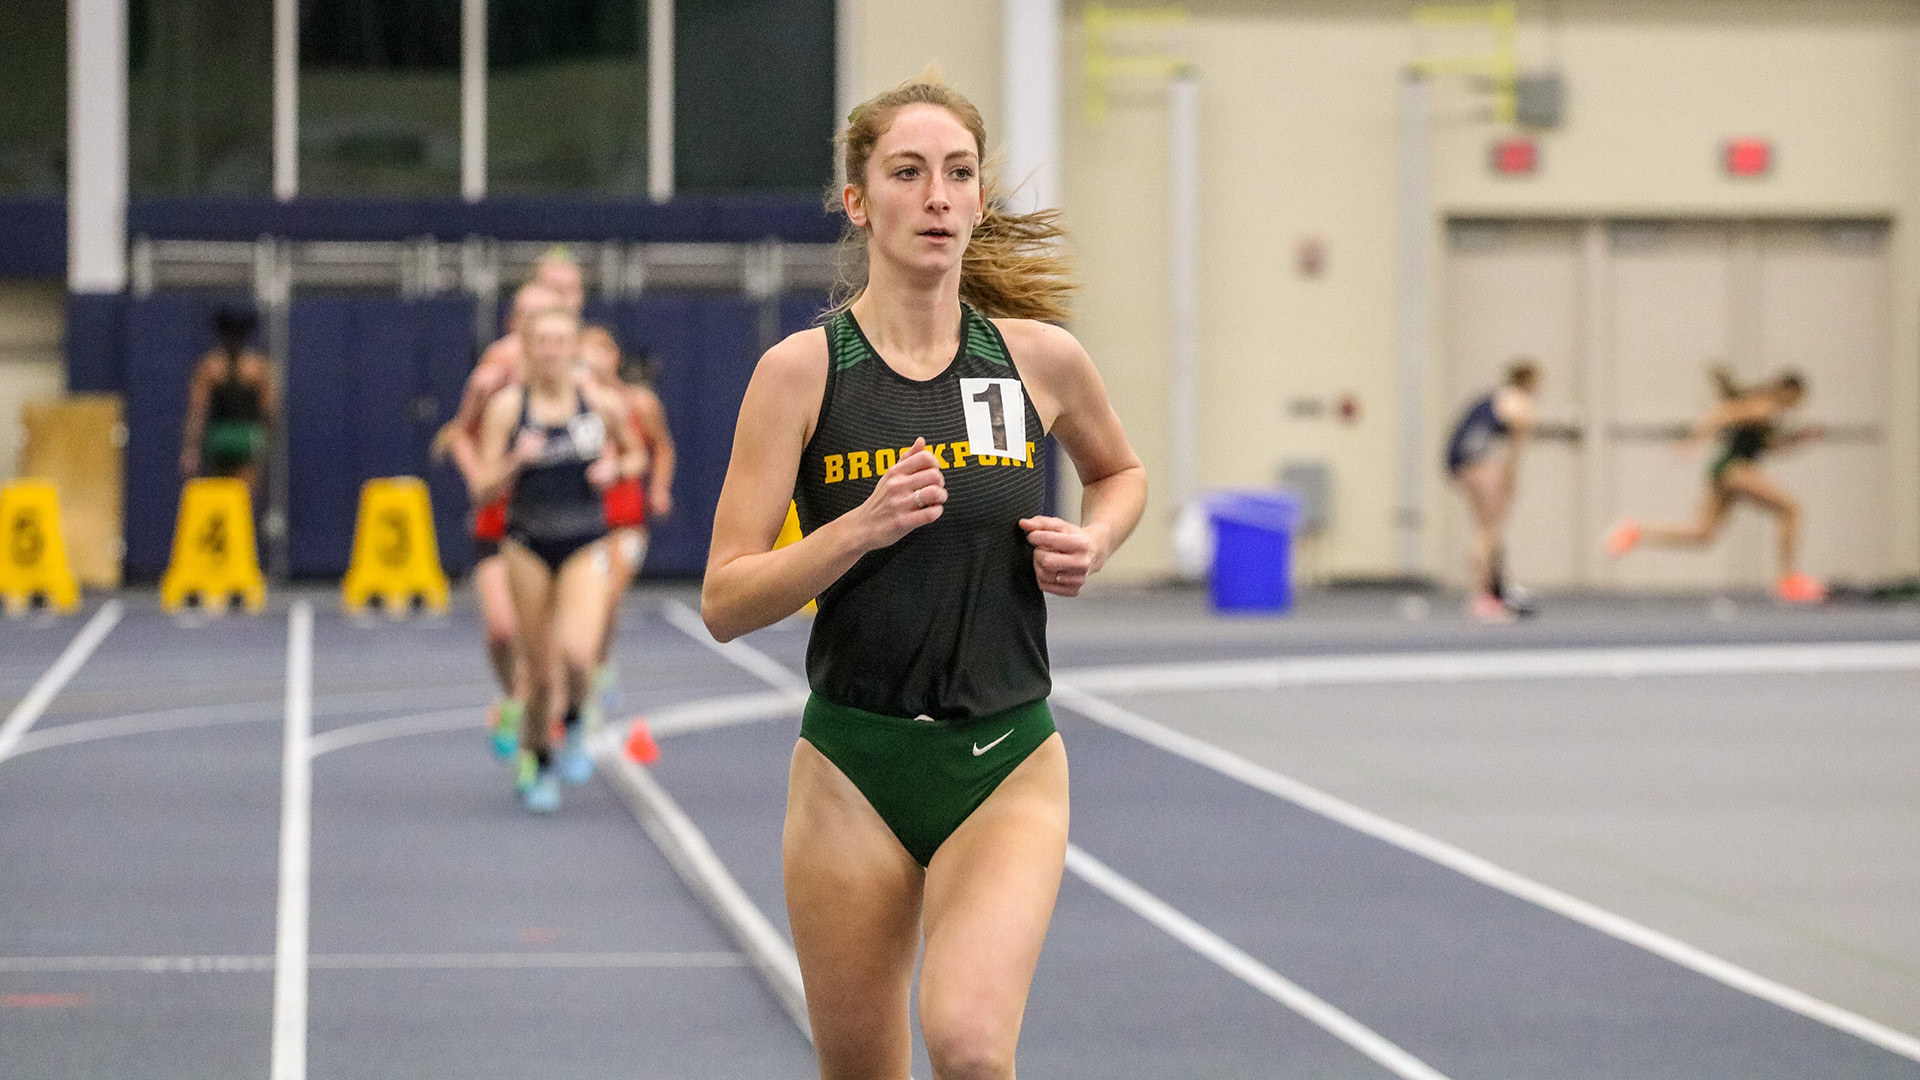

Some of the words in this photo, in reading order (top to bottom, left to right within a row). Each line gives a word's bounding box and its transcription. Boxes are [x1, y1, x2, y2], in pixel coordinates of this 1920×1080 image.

[973, 383, 1008, 452] 1
[824, 440, 1036, 484] BROKPT
[197, 507, 230, 566] 4
[374, 506, 413, 569] 3
